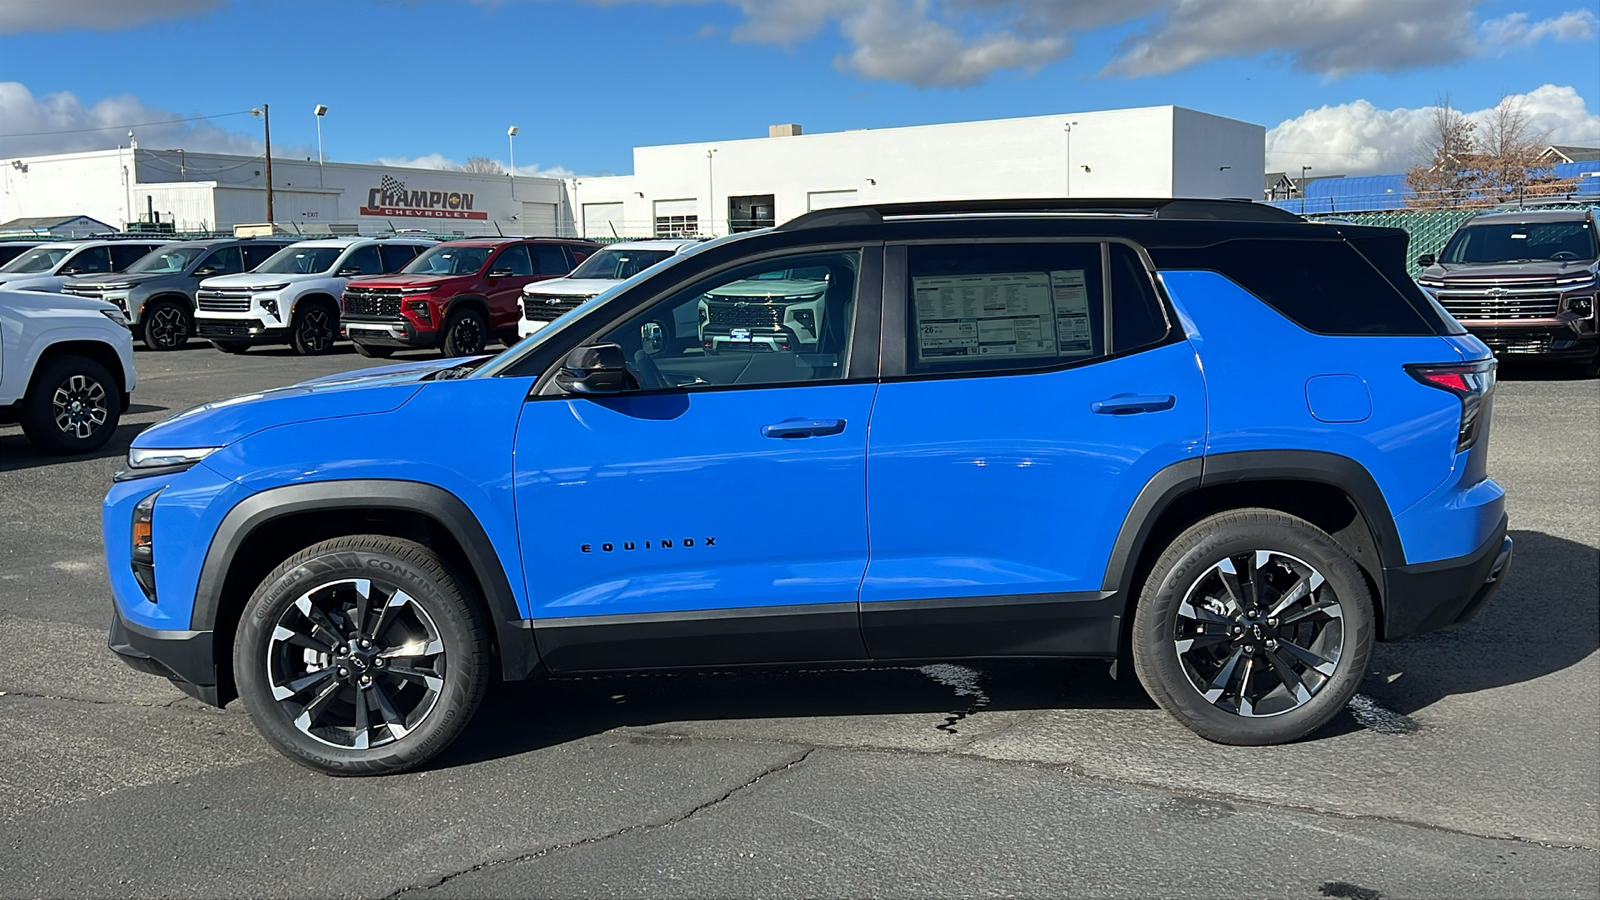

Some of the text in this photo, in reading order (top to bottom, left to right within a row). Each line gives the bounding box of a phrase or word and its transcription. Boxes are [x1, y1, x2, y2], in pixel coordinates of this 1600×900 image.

[367, 187, 474, 211] CHAMPION
[385, 209, 469, 218] CHEVROLET
[924, 326, 934, 334] 26
[580, 537, 716, 553] EQUINOX
[366, 558, 461, 630] CONTINENT
